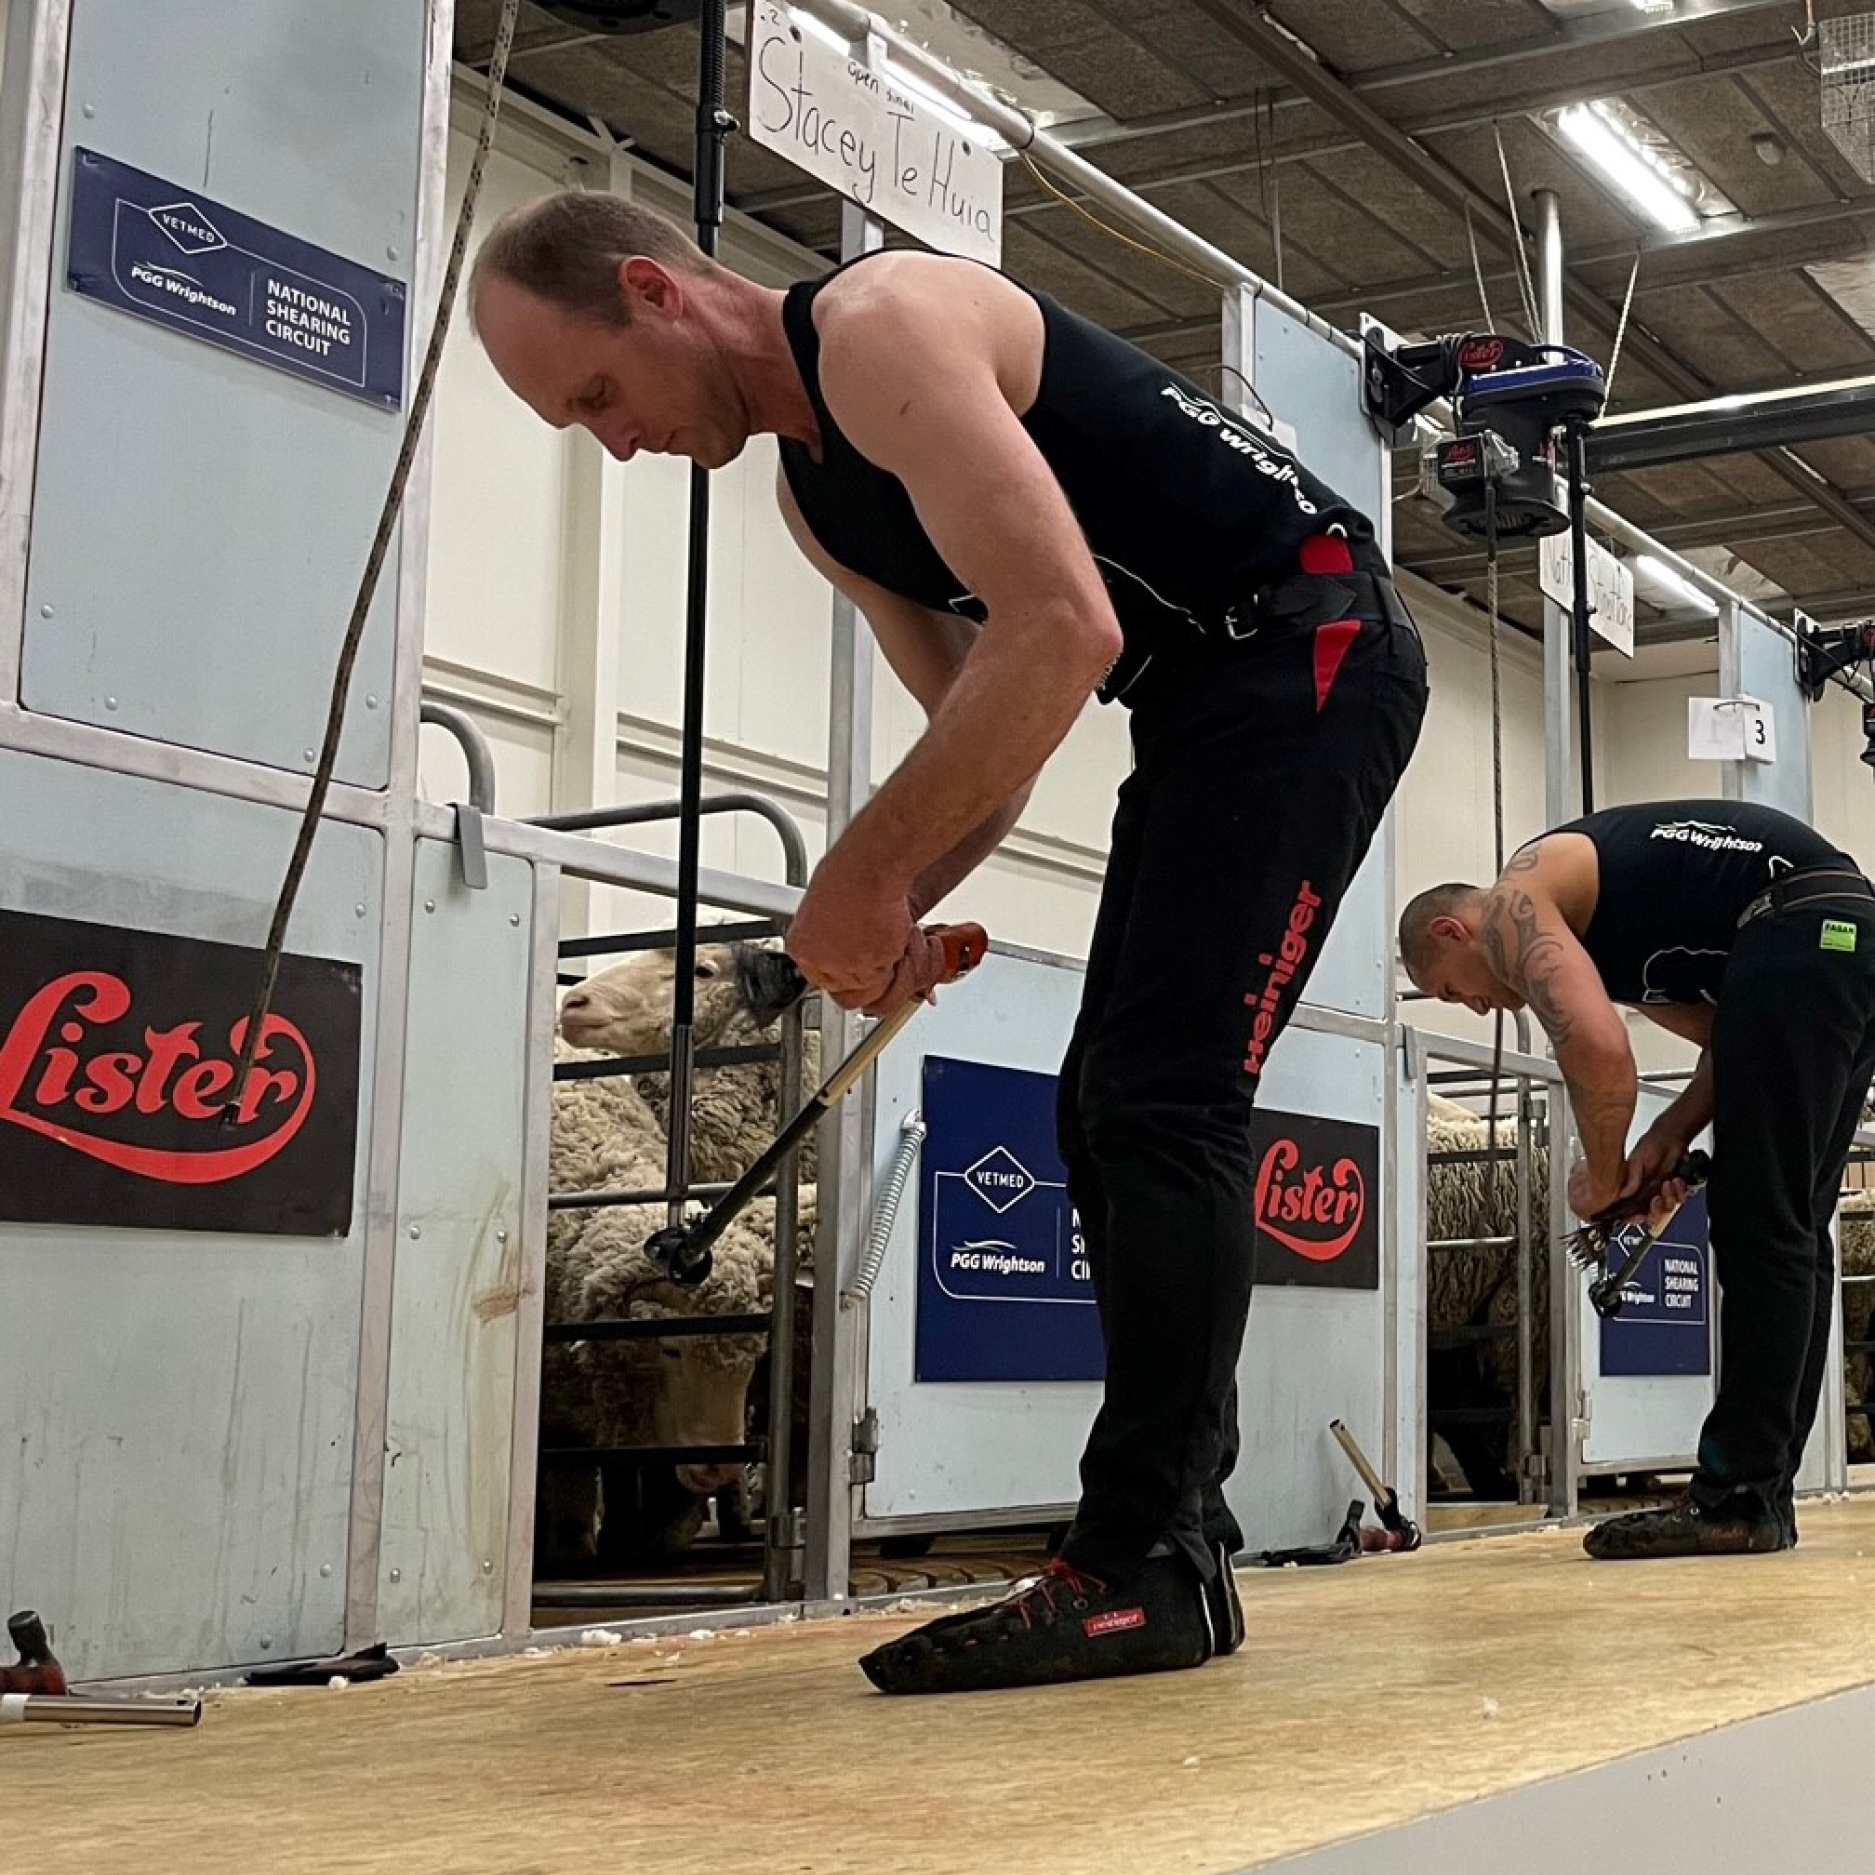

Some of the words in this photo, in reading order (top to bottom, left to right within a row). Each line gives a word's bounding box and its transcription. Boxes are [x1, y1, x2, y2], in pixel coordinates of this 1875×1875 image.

[757, 37, 876, 204] Stacey
[886, 111, 918, 196] Te
[928, 131, 996, 243] Huia
[162, 213, 216, 244] VETMED
[131, 264, 164, 287] PGG
[165, 278, 237, 316] Wrightson
[267, 278, 351, 326] NATIONAL
[265, 319, 332, 356] CIRCUIT
[266, 299, 351, 345] SHEARING
[1755, 719, 1766, 745] 3
[1650, 828, 1689, 842] PGG
[0, 970, 317, 1184] Lister
[975, 1171, 1025, 1189] VETMED
[1253, 1138, 1365, 1261] Lister
[950, 1252, 980, 1270] PGG
[981, 1254, 1046, 1276] Wrightson
[1664, 1258, 1699, 1275] NATIONAL
[1664, 1275, 1699, 1292] SHEARING
[1665, 1294, 1692, 1309] CIRCUIT
